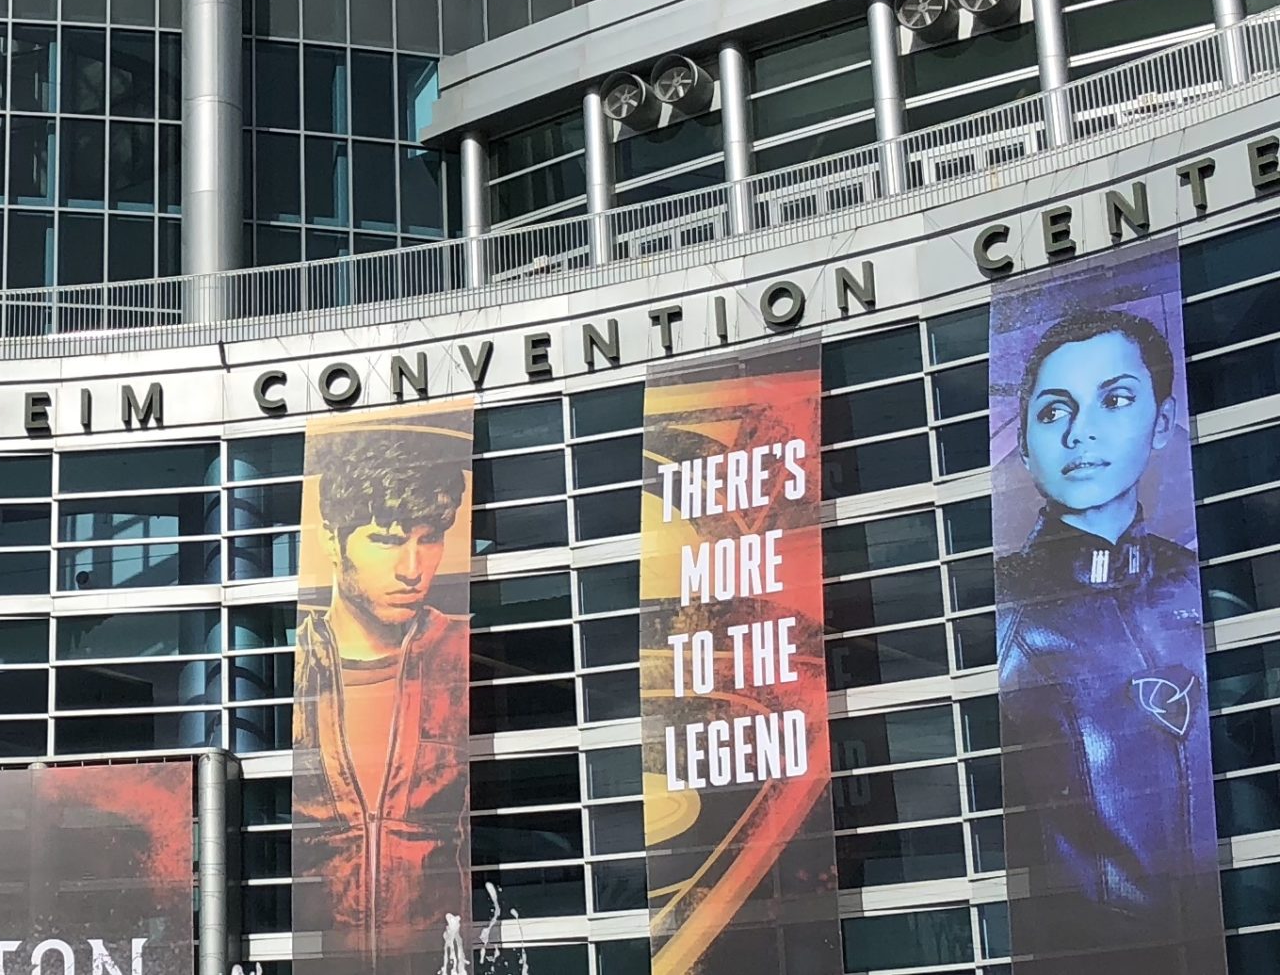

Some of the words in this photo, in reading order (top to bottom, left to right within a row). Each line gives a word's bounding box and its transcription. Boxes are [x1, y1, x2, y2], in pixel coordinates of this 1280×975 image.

[253, 260, 876, 414] CONVENTION
[658, 438, 806, 523] THERE'S
[680, 528, 784, 607] MORE
[667, 631, 714, 698] TO
[728, 617, 798, 692] THE
[665, 710, 808, 791] LEGEND
